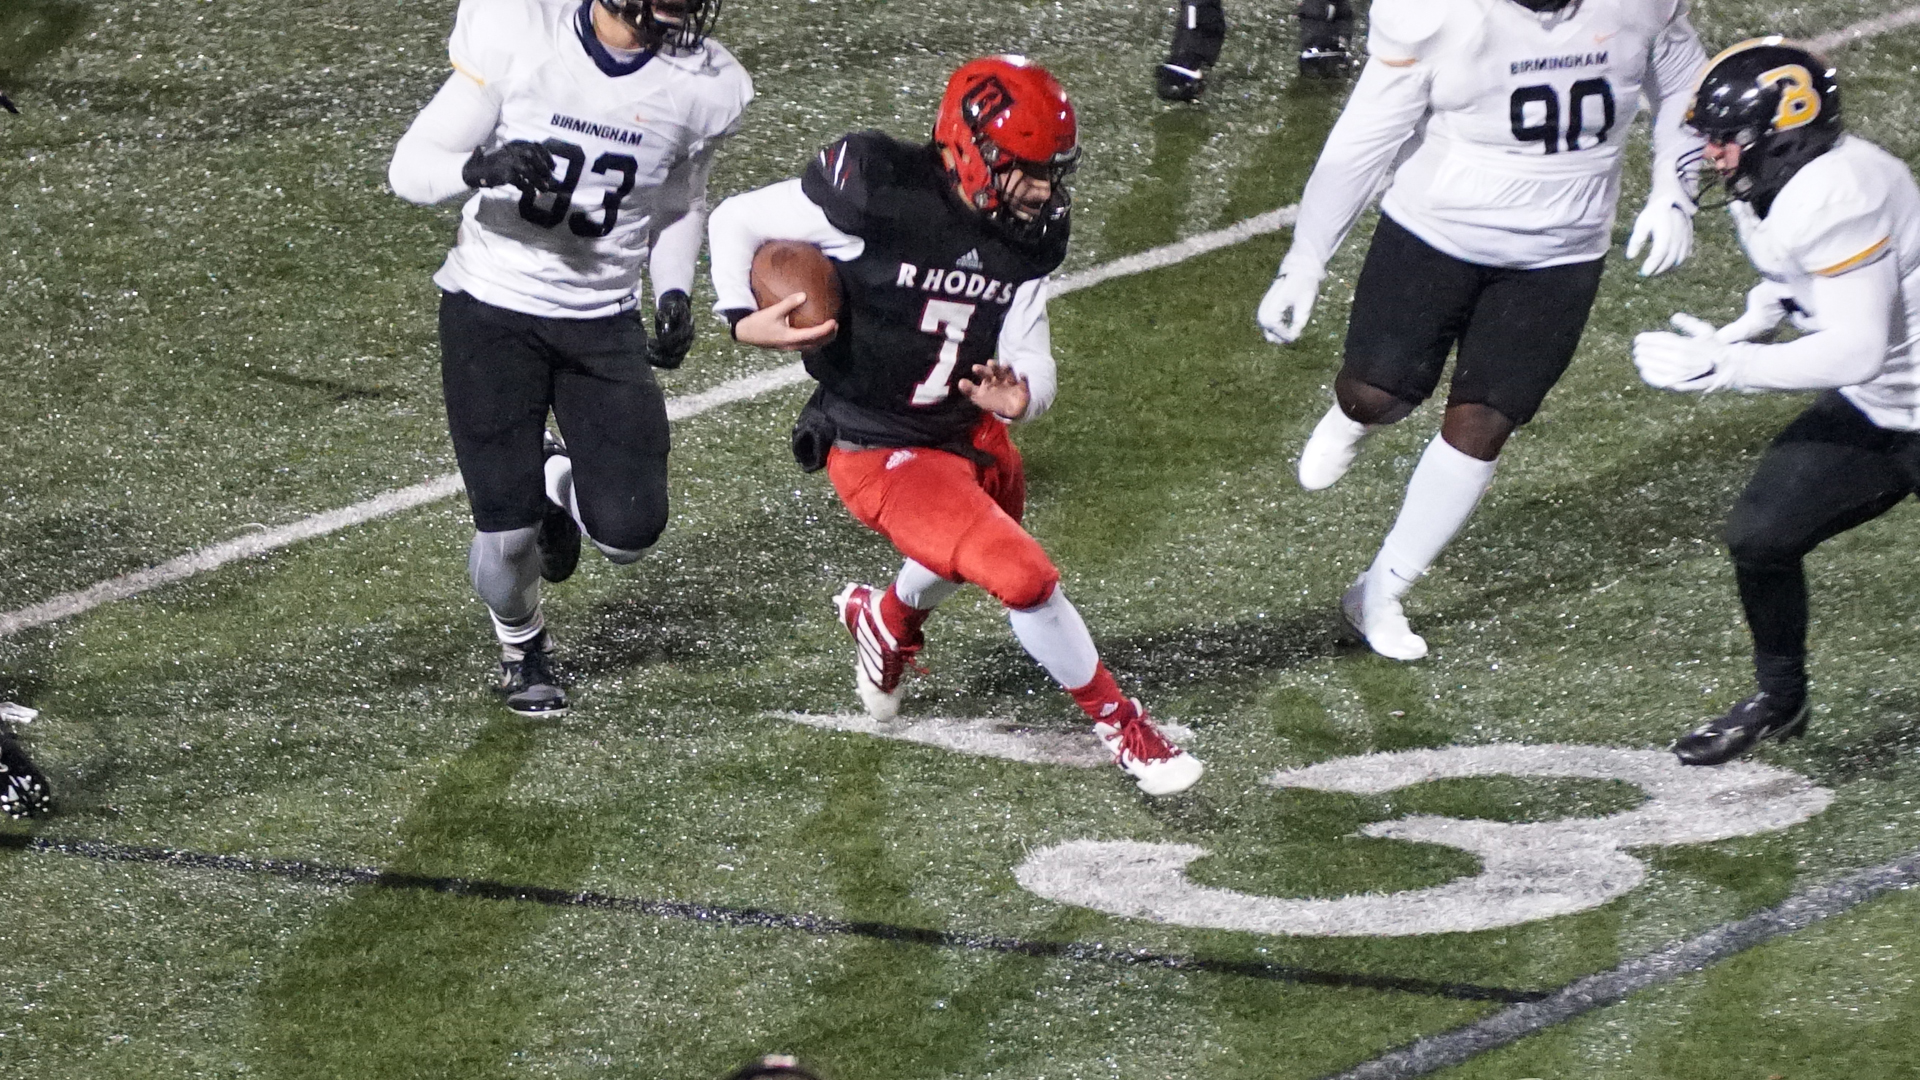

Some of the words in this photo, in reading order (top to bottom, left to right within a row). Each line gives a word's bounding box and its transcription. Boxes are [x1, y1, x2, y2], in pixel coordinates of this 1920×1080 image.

[1510, 50, 1609, 75] BIRMINGHAM
[550, 112, 644, 147] BIRMINGHAM
[1510, 76, 1615, 155] 90
[1755, 63, 1822, 133] B
[896, 262, 1014, 304] RHODES
[911, 297, 976, 407] 7
[1015, 743, 1834, 936] 3
